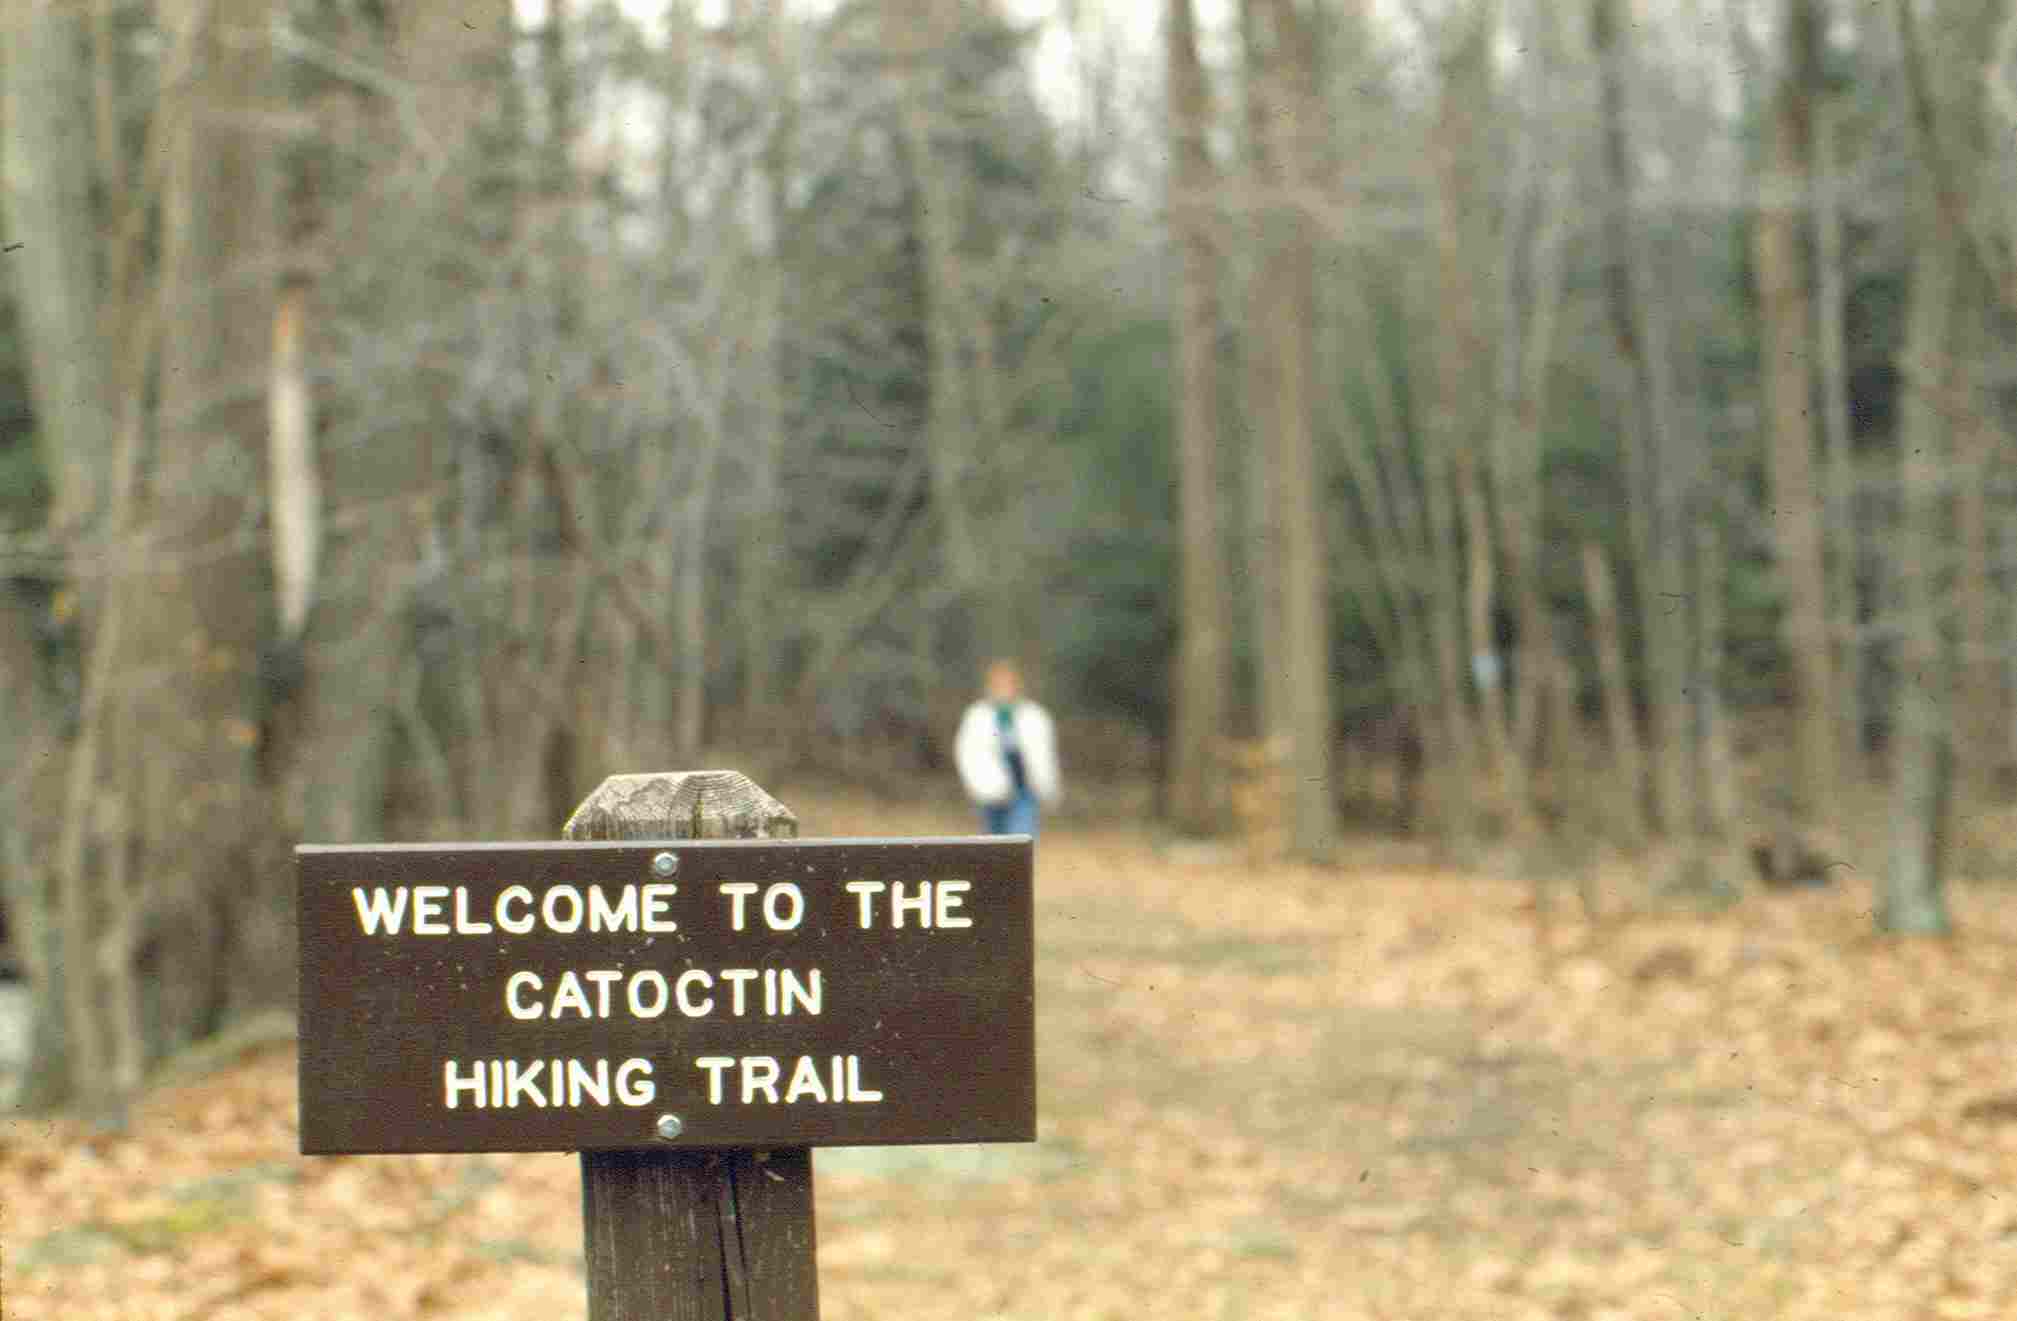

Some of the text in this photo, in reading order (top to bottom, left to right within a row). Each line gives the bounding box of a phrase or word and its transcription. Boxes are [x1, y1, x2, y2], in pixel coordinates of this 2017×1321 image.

[352, 880, 973, 936] WELCOME TO THE
[506, 968, 823, 1020] CATOCTIN
[444, 1054, 884, 1110] HIKING TRAIL
